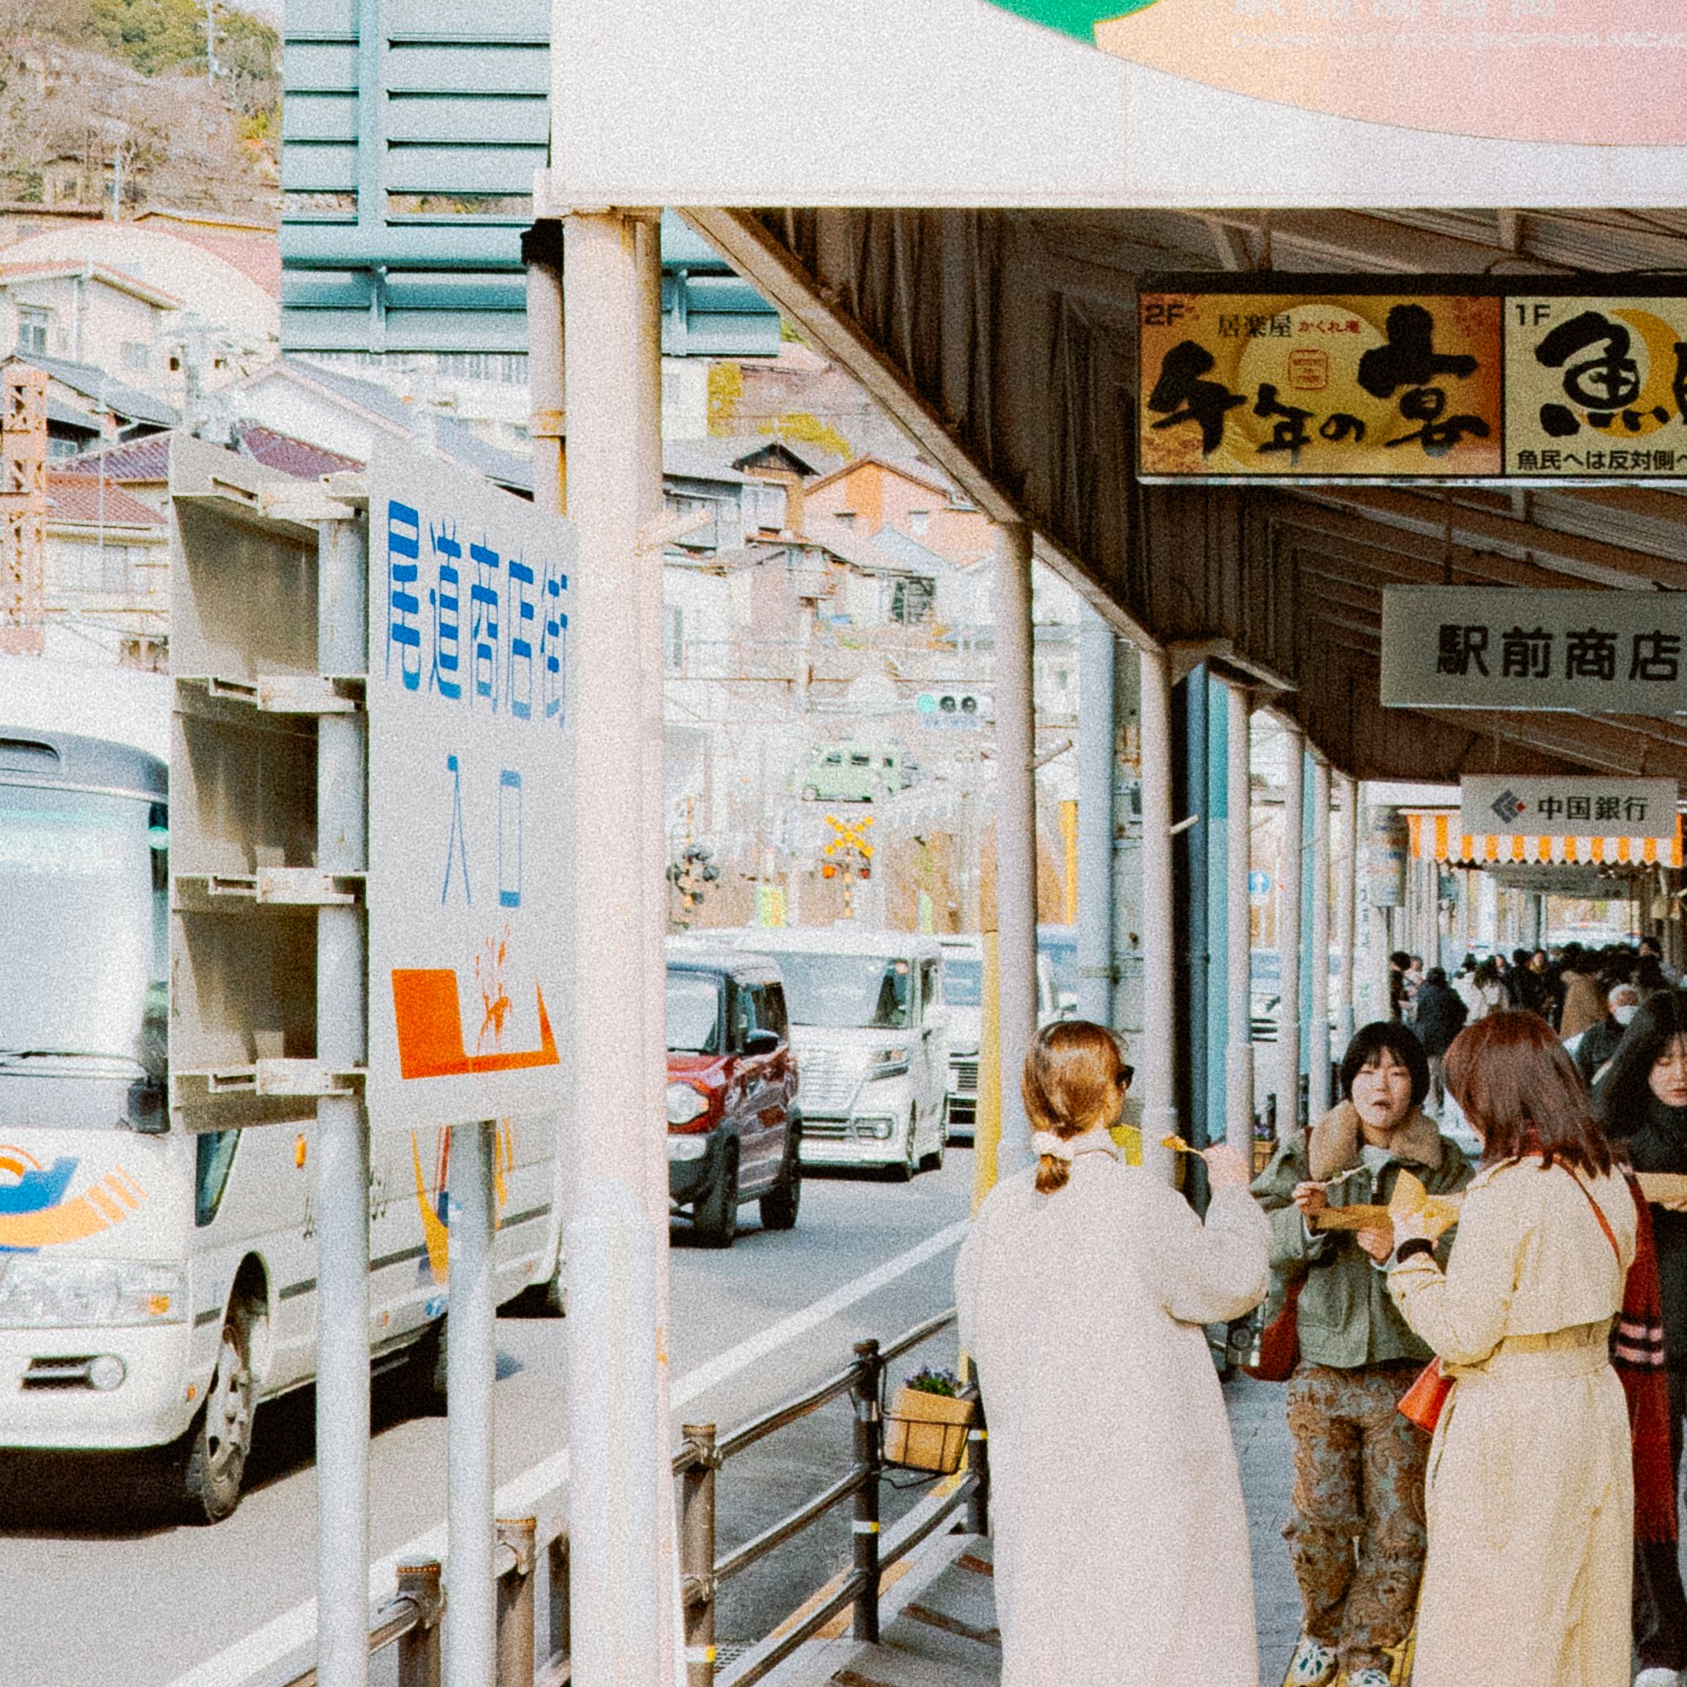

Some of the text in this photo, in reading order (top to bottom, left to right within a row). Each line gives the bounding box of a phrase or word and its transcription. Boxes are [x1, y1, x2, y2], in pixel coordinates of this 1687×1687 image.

[1145, 303, 1186, 326] 2F
[1217, 314, 1293, 339] 居楽屋
[1515, 304, 1550, 326] 1F
[386, 498, 570, 727] 尾道商店街
[1537, 795, 1650, 821] 中国銀行
